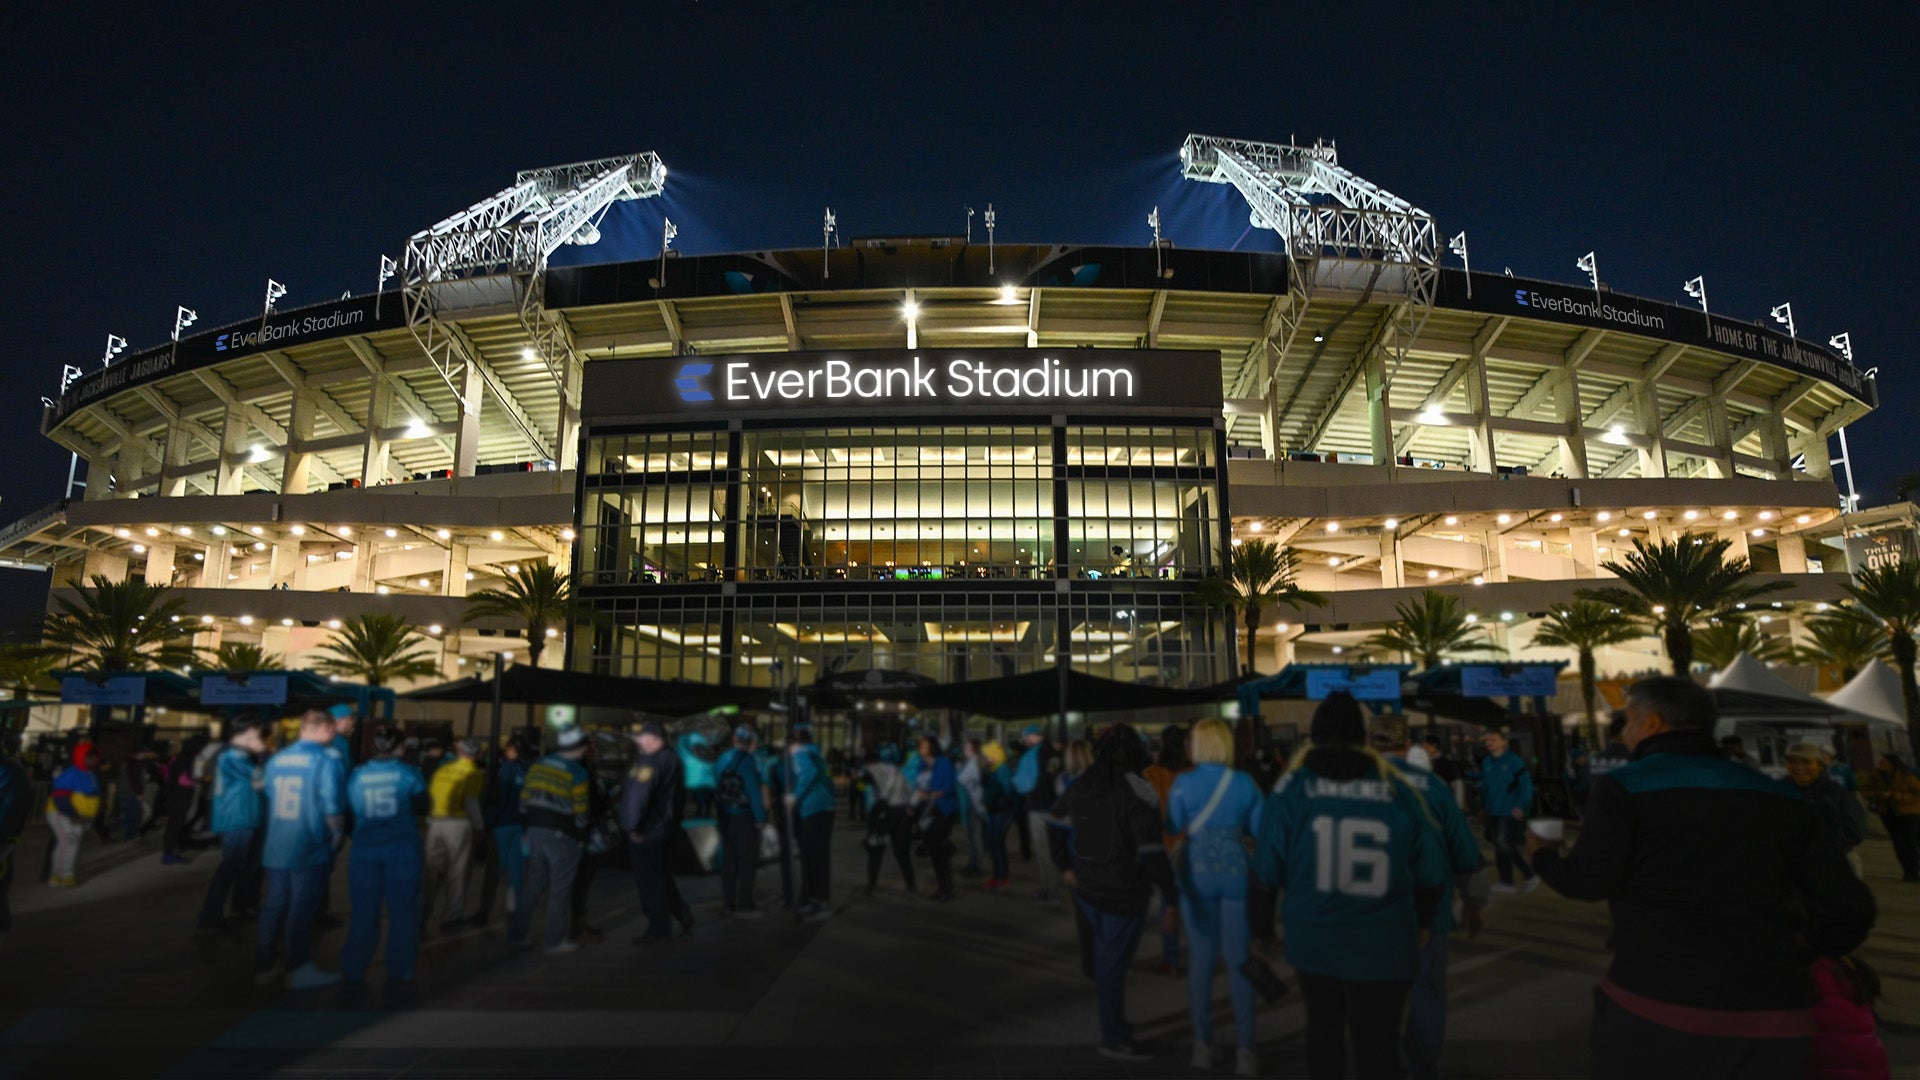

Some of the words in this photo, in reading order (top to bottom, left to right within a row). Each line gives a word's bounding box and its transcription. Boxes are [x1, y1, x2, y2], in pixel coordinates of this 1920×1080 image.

[302, 309, 363, 334] Stadium
[1531, 292, 1600, 317] EverBank
[1603, 305, 1664, 330] Stadium
[1714, 325, 1744, 349] HOME
[1745, 332, 1758, 351] OF
[1761, 336, 1779, 358] THE
[129, 352, 171, 380] JAGUARS
[726, 358, 935, 400] EverBank
[946, 358, 1133, 398] Stadium
[1864, 547, 1888, 556] THIS
[1867, 552, 1901, 570] OUR
[273, 775, 303, 820] 16
[363, 786, 398, 819] 15
[1312, 813, 1390, 898] 16
